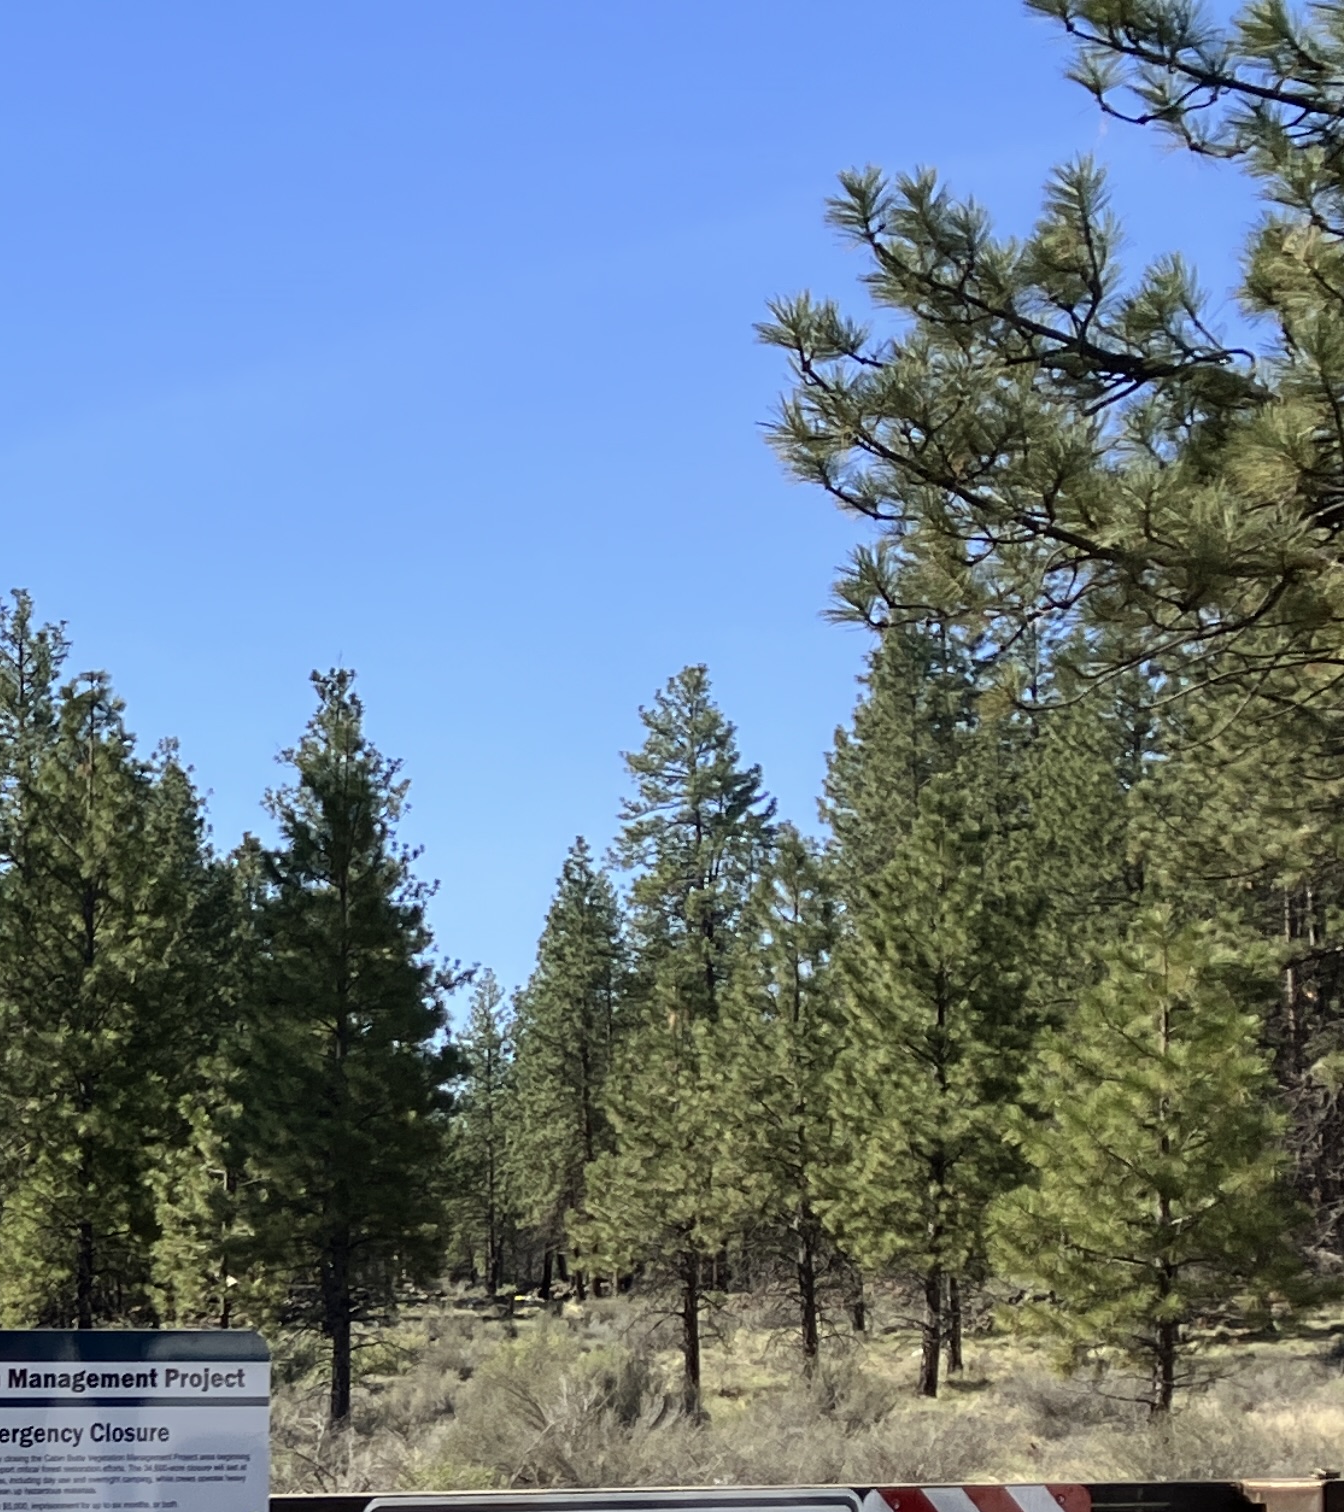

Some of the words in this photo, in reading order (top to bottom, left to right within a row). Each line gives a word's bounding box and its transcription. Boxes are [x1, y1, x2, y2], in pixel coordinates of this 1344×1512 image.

[8, 1368, 158, 1393] Management
[165, 1368, 245, 1391] Project
[90, 1422, 170, 1442] Closure
